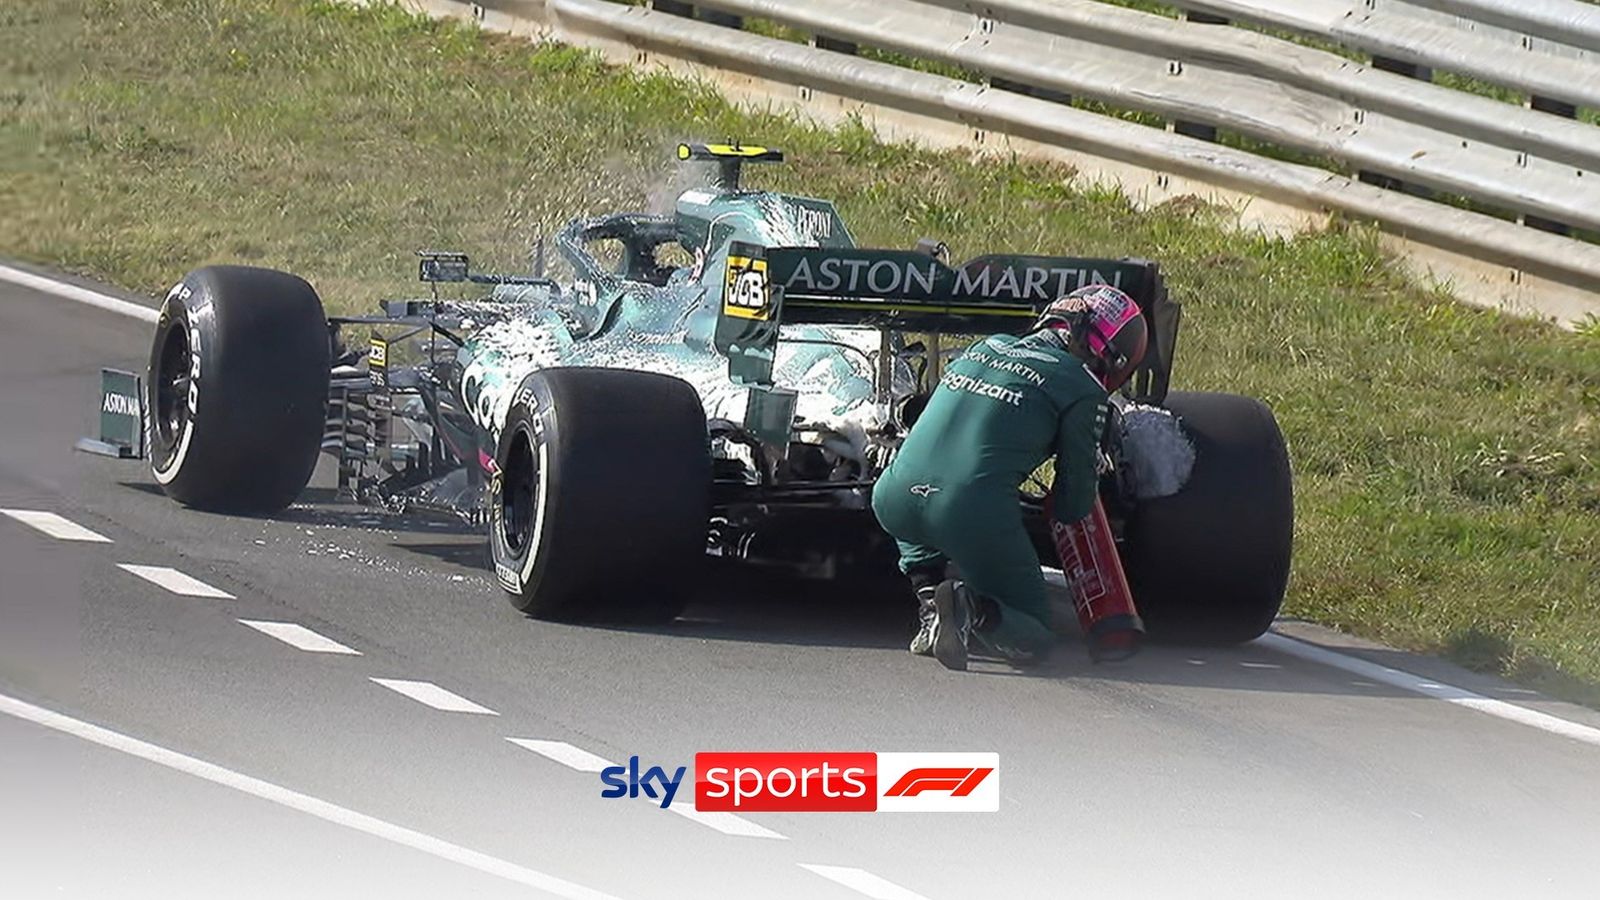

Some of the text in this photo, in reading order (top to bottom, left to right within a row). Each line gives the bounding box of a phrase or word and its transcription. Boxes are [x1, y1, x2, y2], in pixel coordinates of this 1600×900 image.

[728, 269, 768, 307] JCB
[788, 257, 1121, 300] ASTON MARTIN
[989, 359, 1045, 387] MARTIN
